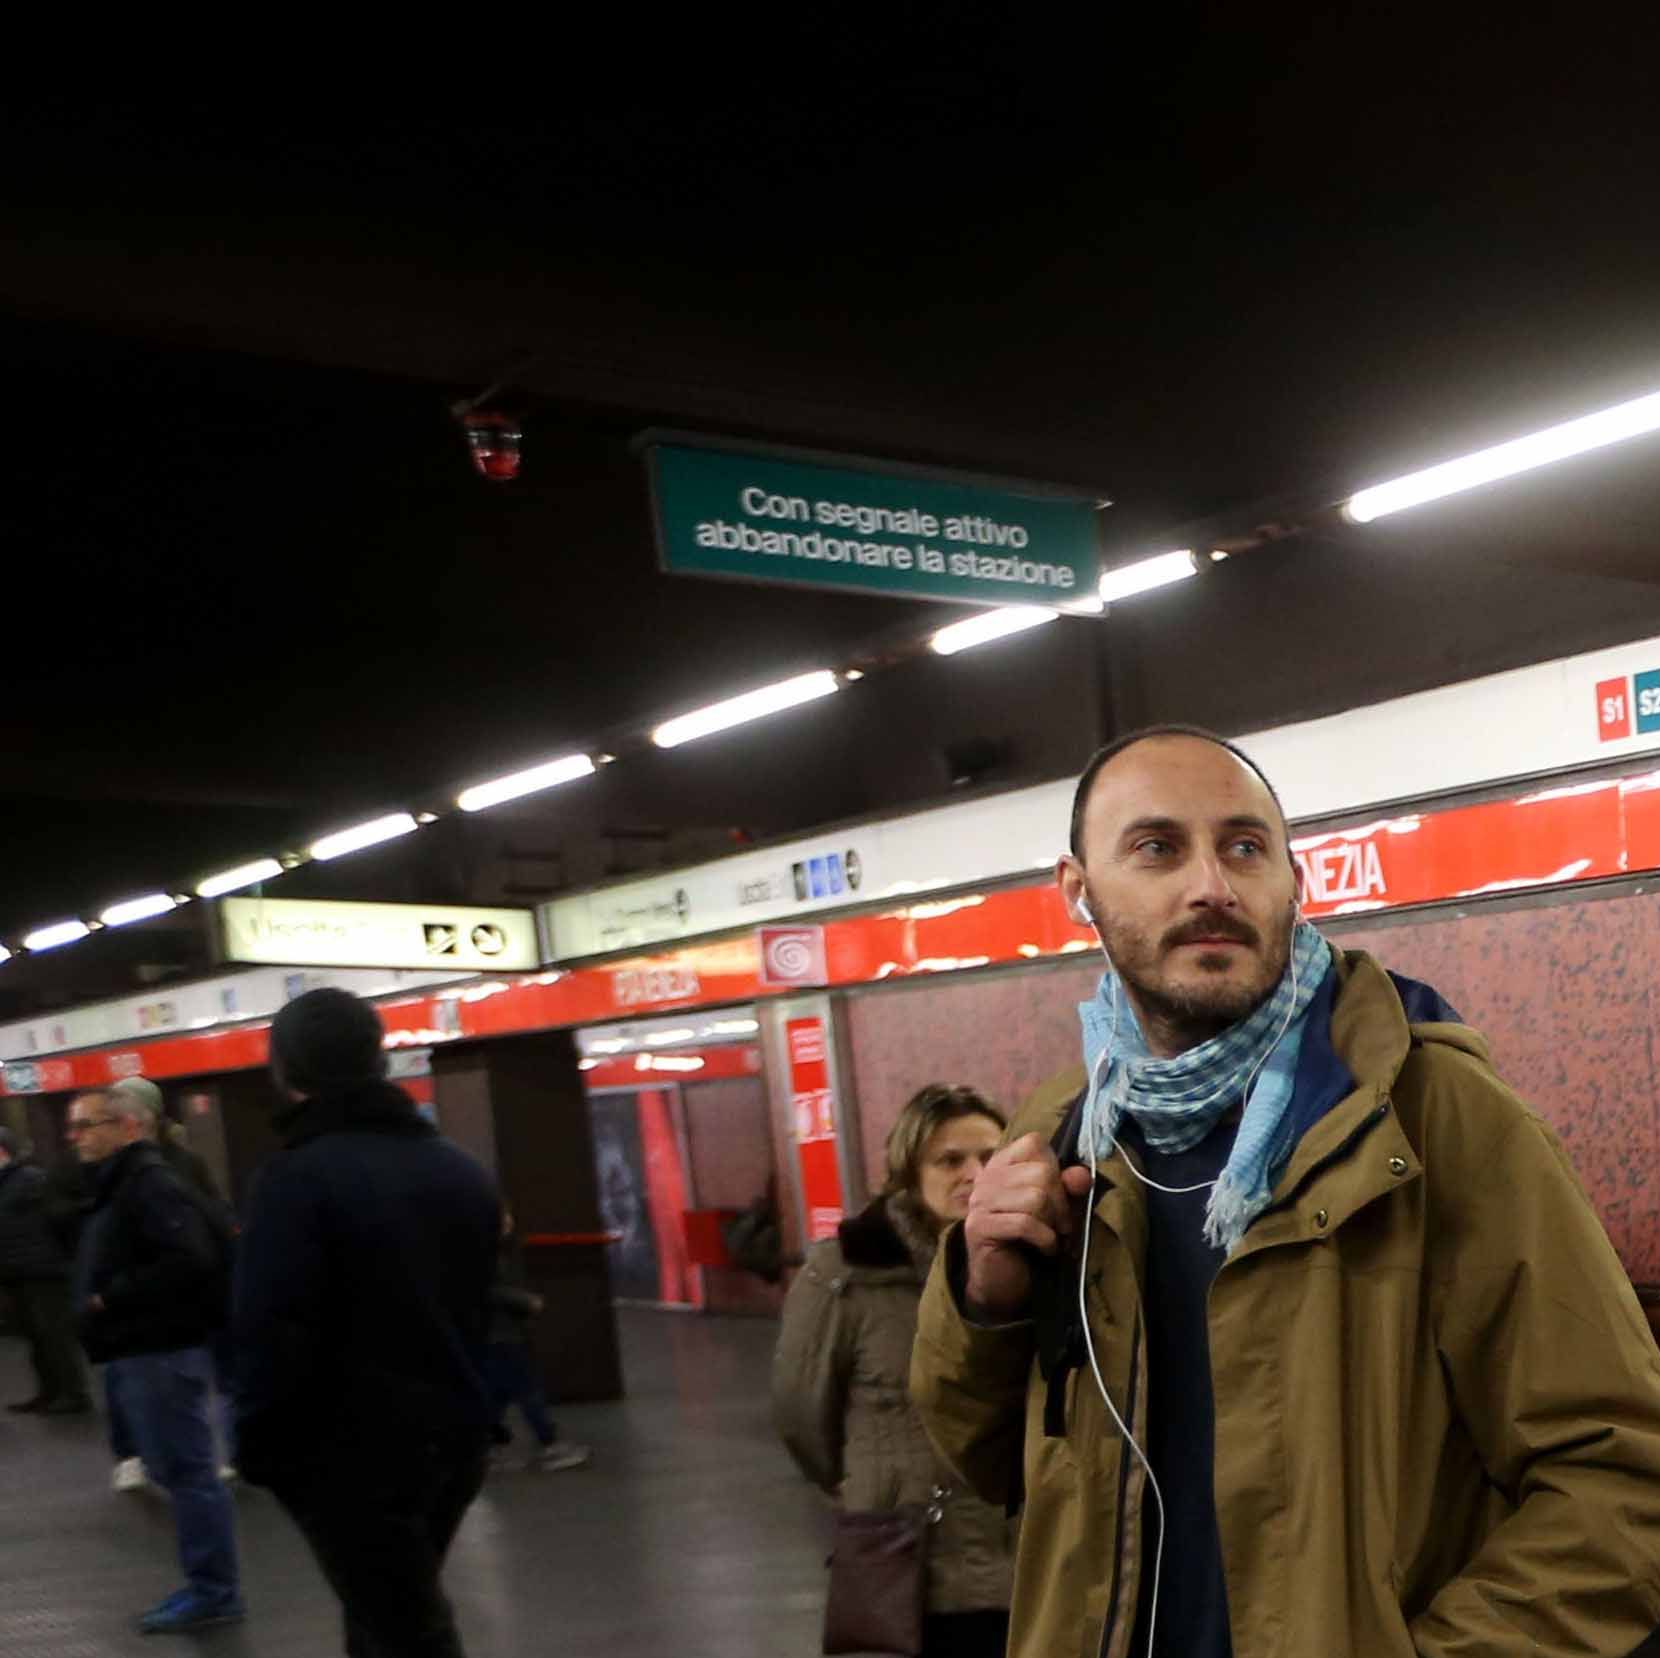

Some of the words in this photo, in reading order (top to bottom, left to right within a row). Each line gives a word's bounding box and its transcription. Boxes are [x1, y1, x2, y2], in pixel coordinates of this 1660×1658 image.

[741, 487, 810, 522] Con
[814, 500, 940, 536] segnale
[943, 514, 1029, 549] attivo
[695, 521, 914, 569] abbandonare
[918, 543, 946, 574] la
[949, 552, 1076, 589] stazione
[1602, 696, 1625, 723] S1
[1296, 842, 1387, 905] NEZIA
